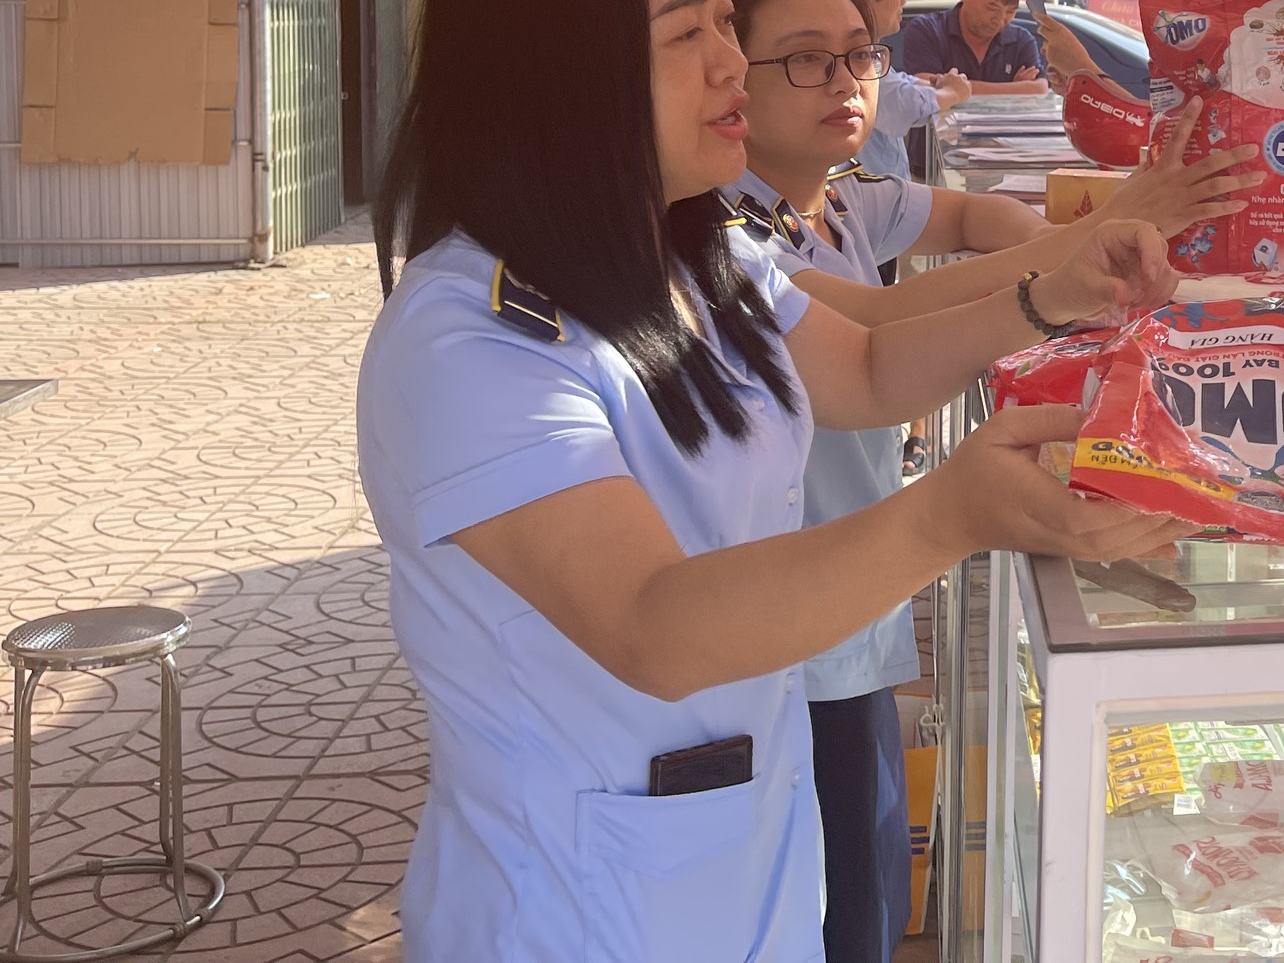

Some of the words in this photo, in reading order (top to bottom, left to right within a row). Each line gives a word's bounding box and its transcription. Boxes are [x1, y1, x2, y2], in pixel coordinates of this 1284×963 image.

[1167, 17, 1208, 46] OMO
[1224, 333, 1274, 345] HÀNG
[1241, 358, 1280, 370] BAY
